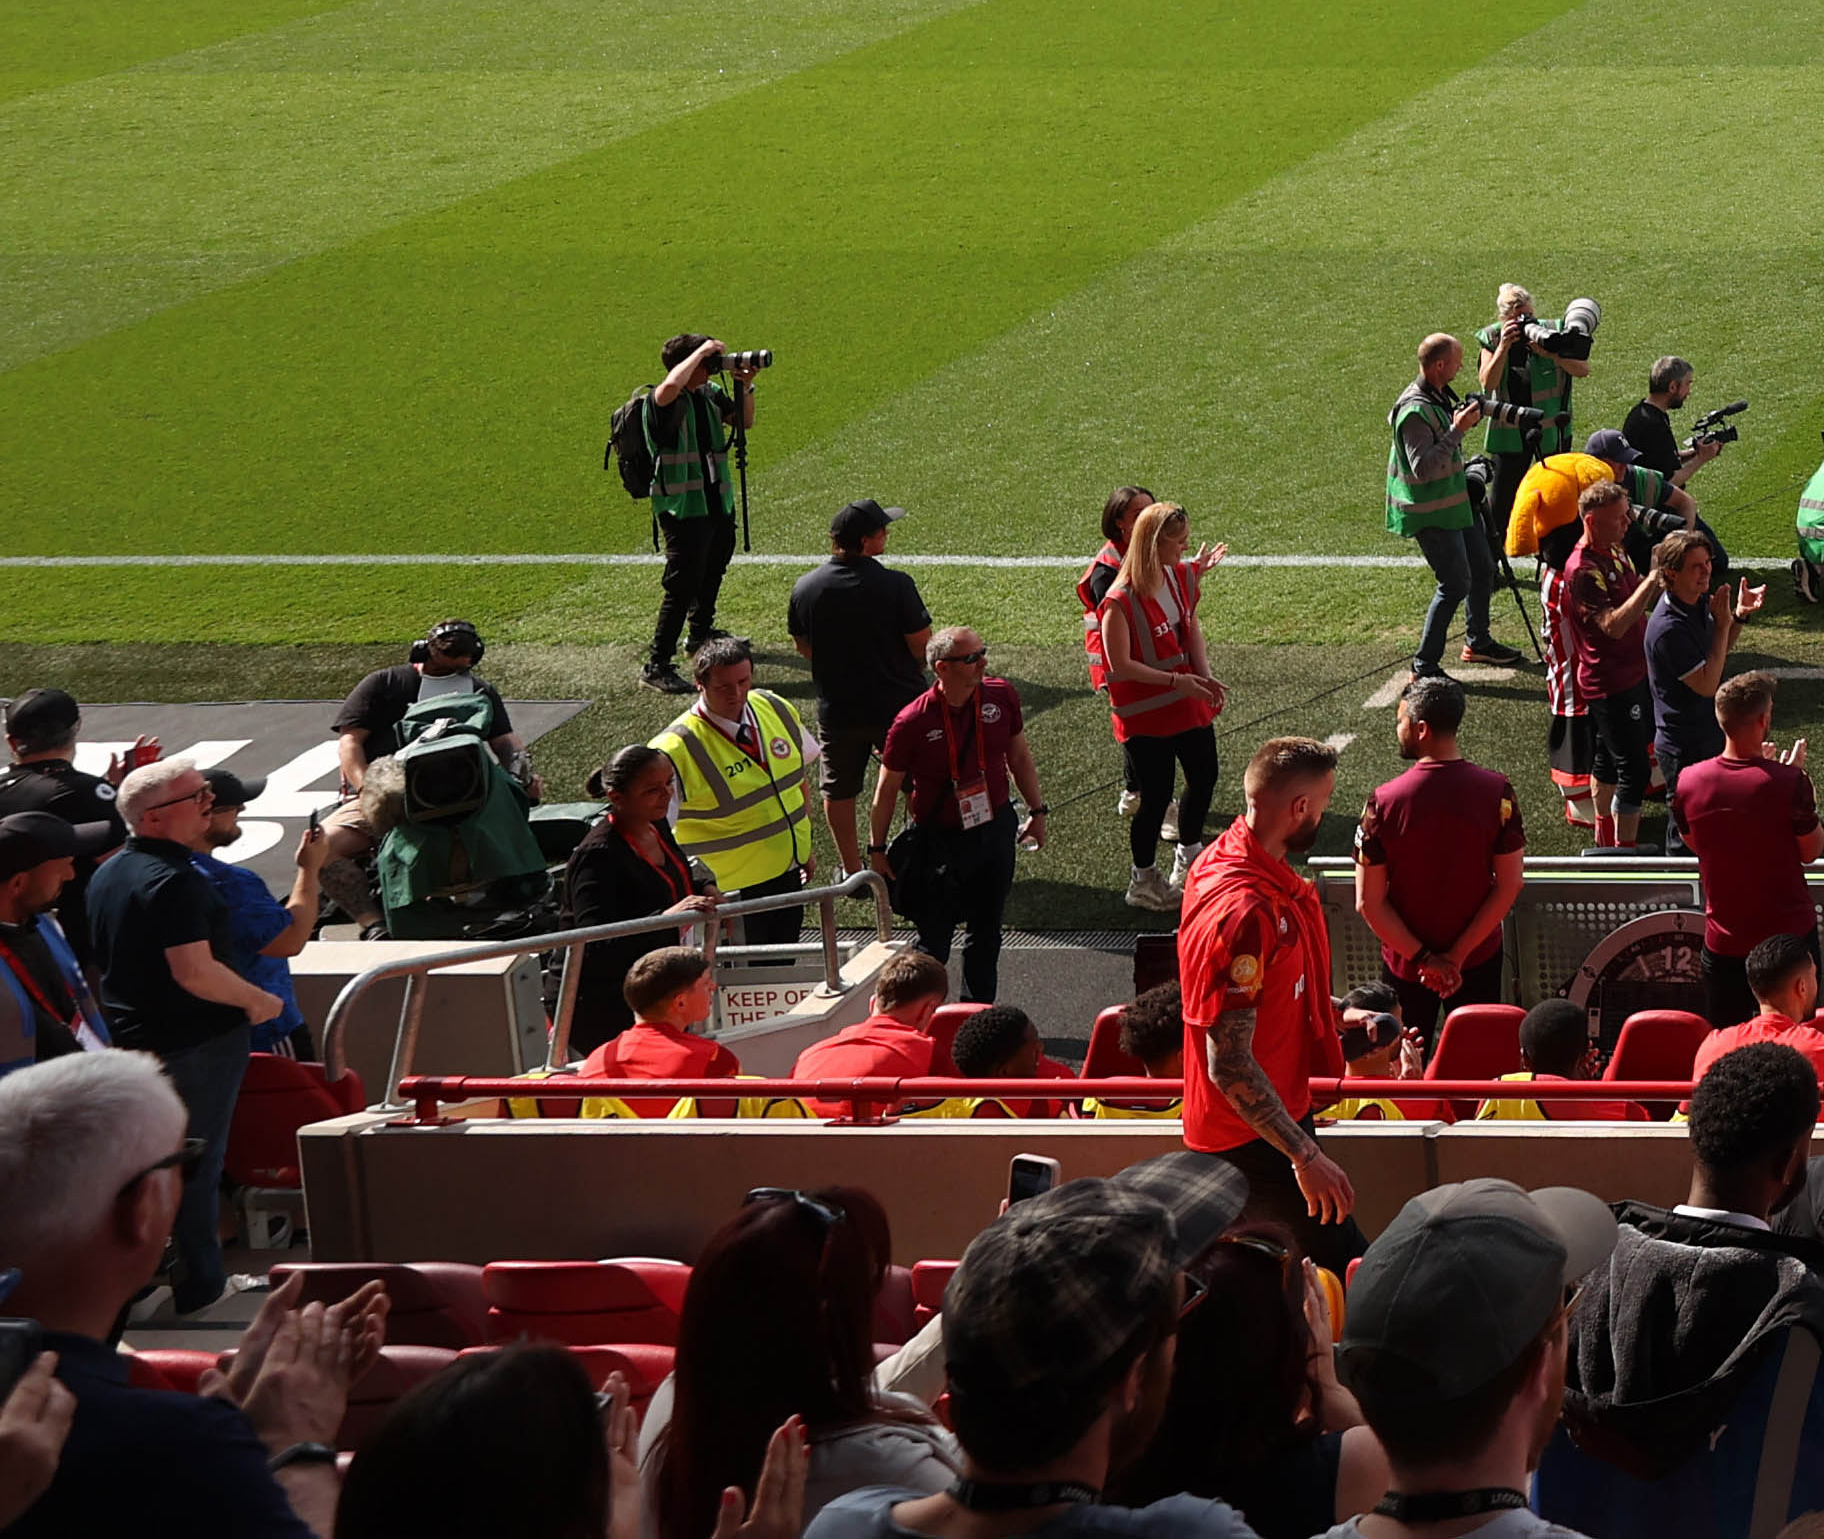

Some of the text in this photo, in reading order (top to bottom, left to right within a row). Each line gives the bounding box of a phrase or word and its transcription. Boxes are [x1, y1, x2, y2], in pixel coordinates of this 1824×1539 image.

[725, 757, 752, 778] 201
[1660, 946, 1691, 971] 12
[727, 989, 812, 1007] KEEP OF
